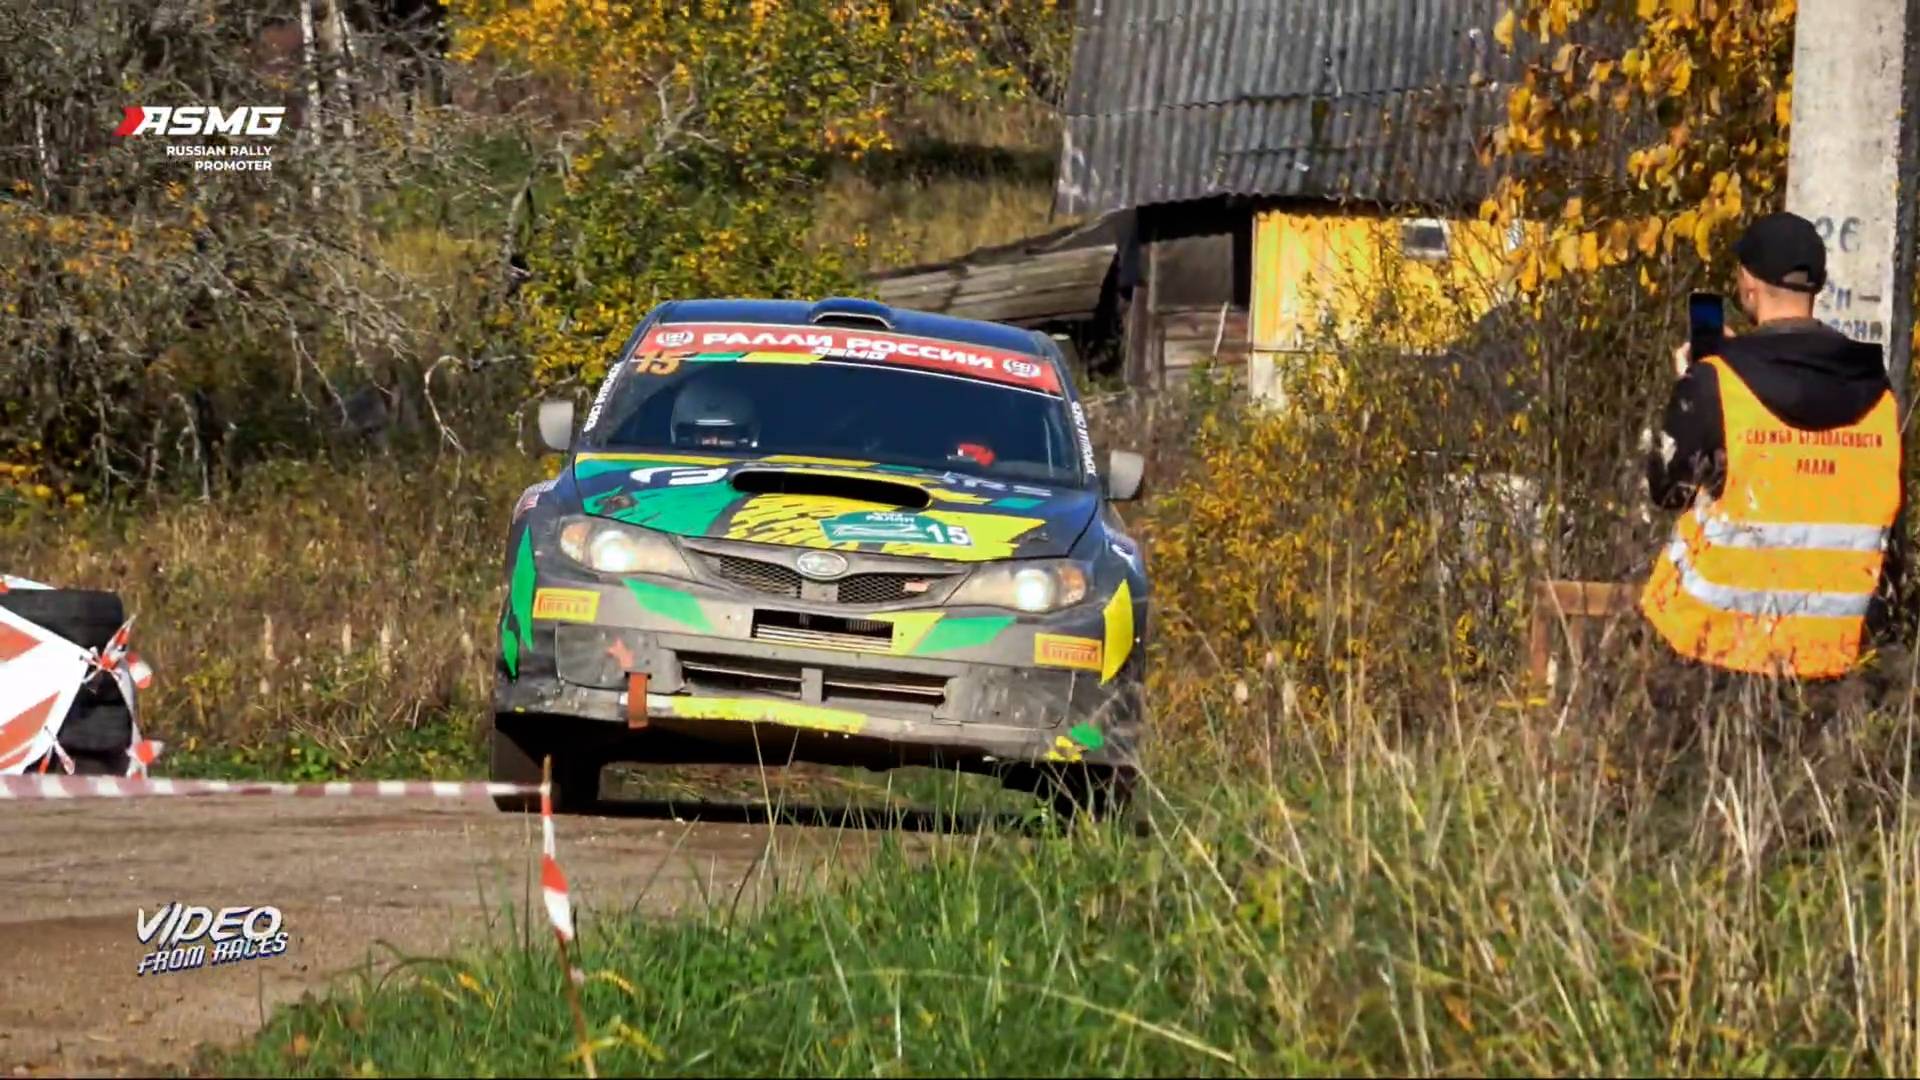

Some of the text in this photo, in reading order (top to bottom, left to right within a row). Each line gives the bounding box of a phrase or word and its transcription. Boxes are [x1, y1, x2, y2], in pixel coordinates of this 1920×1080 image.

[703, 332, 833, 347] РАЛЛИ
[847, 338, 993, 369] РОССИИ
[633, 350, 680, 375] 15
[1797, 458, 1836, 475] РАЛЛИ
[926, 524, 971, 544] 15
